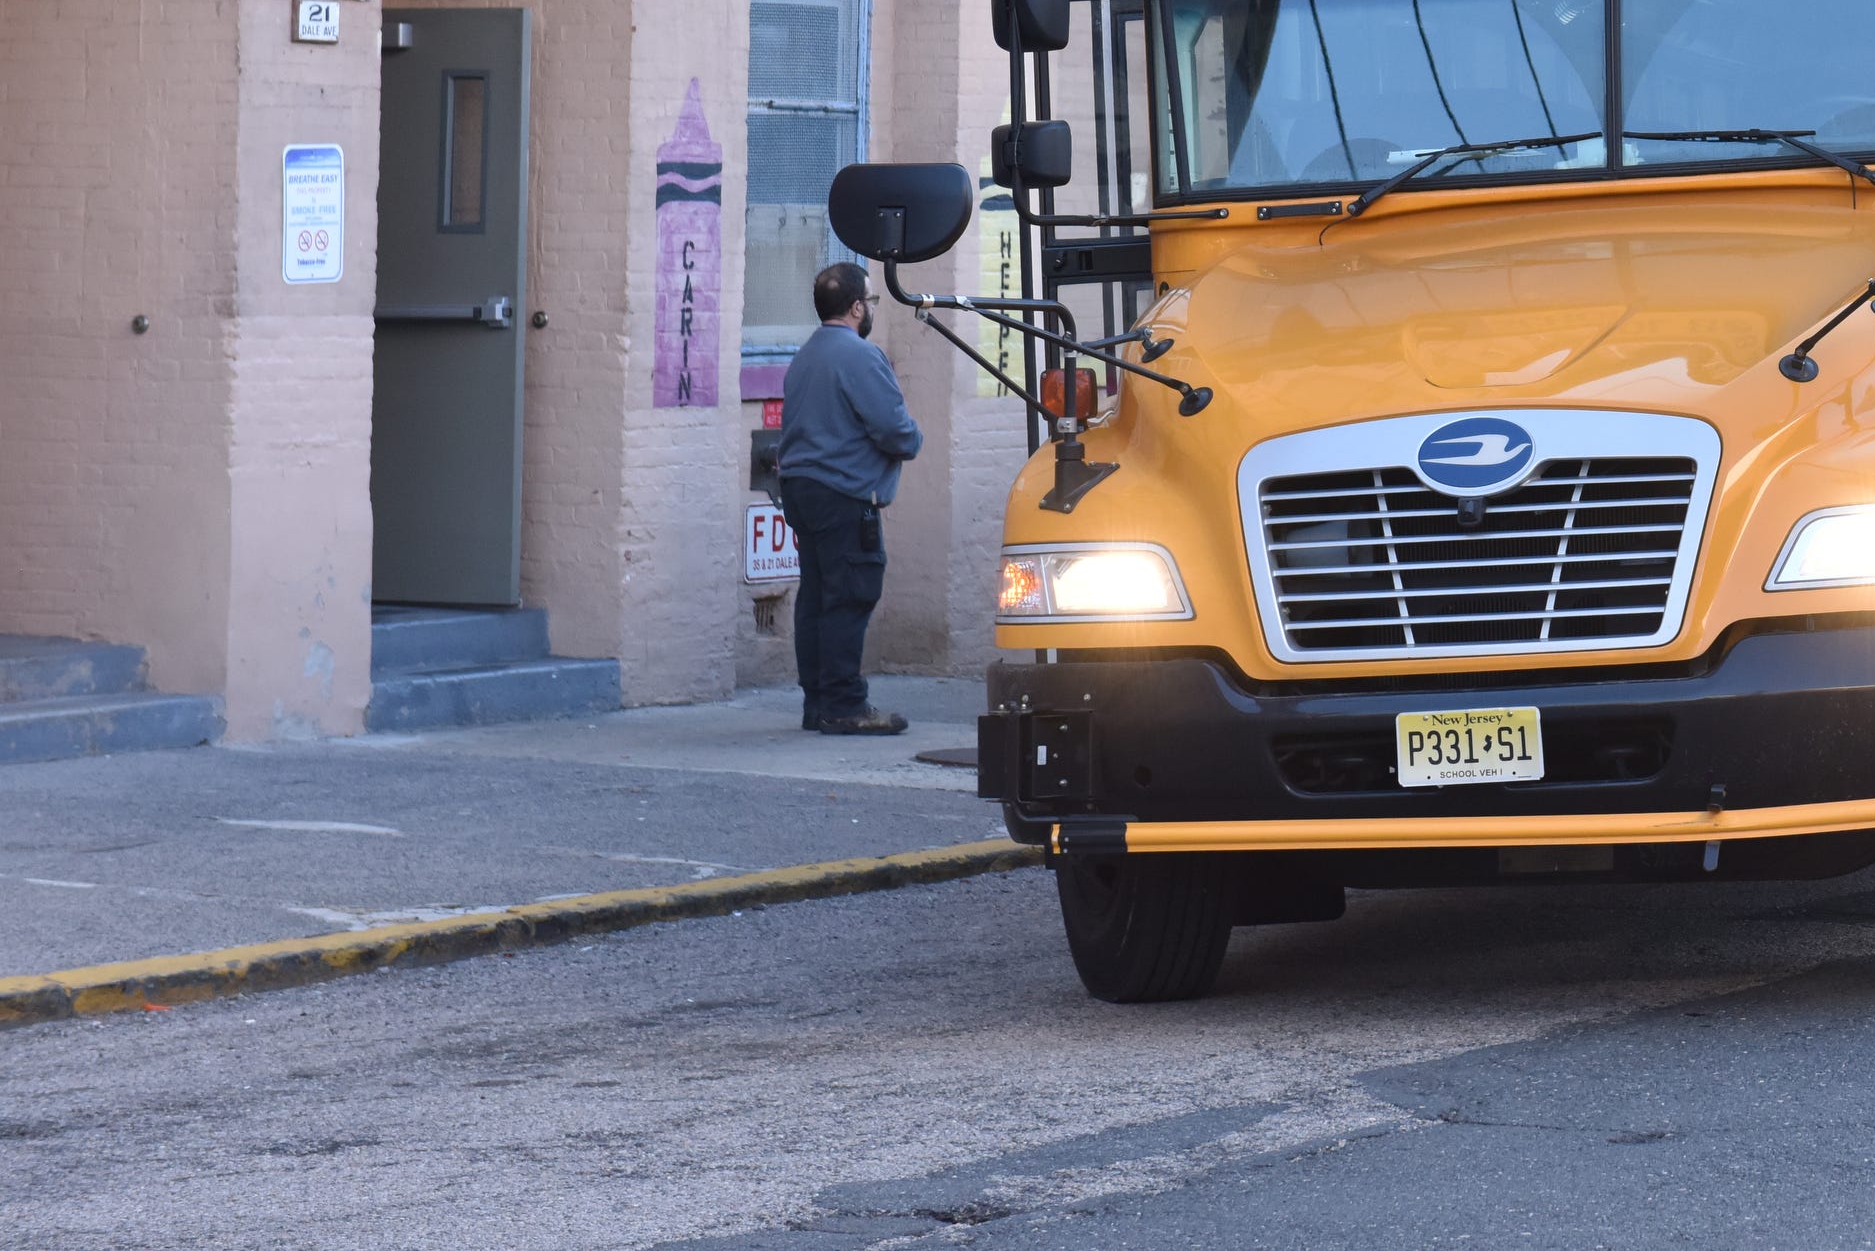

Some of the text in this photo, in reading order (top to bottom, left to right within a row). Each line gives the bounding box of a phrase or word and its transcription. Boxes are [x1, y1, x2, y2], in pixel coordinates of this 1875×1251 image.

[308, 4, 330, 22] 21
[302, 24, 338, 37] DALE AVE
[288, 173, 338, 185] BREATHE EASY
[678, 240, 695, 407] CARIN
[776, 557, 792, 569] DALE
[1432, 713, 1504, 727] New Jersey
[1408, 725, 1532, 767] P331 S1
[1439, 770, 1477, 779] SCHOOL
[1480, 768, 1498, 776] VEH
